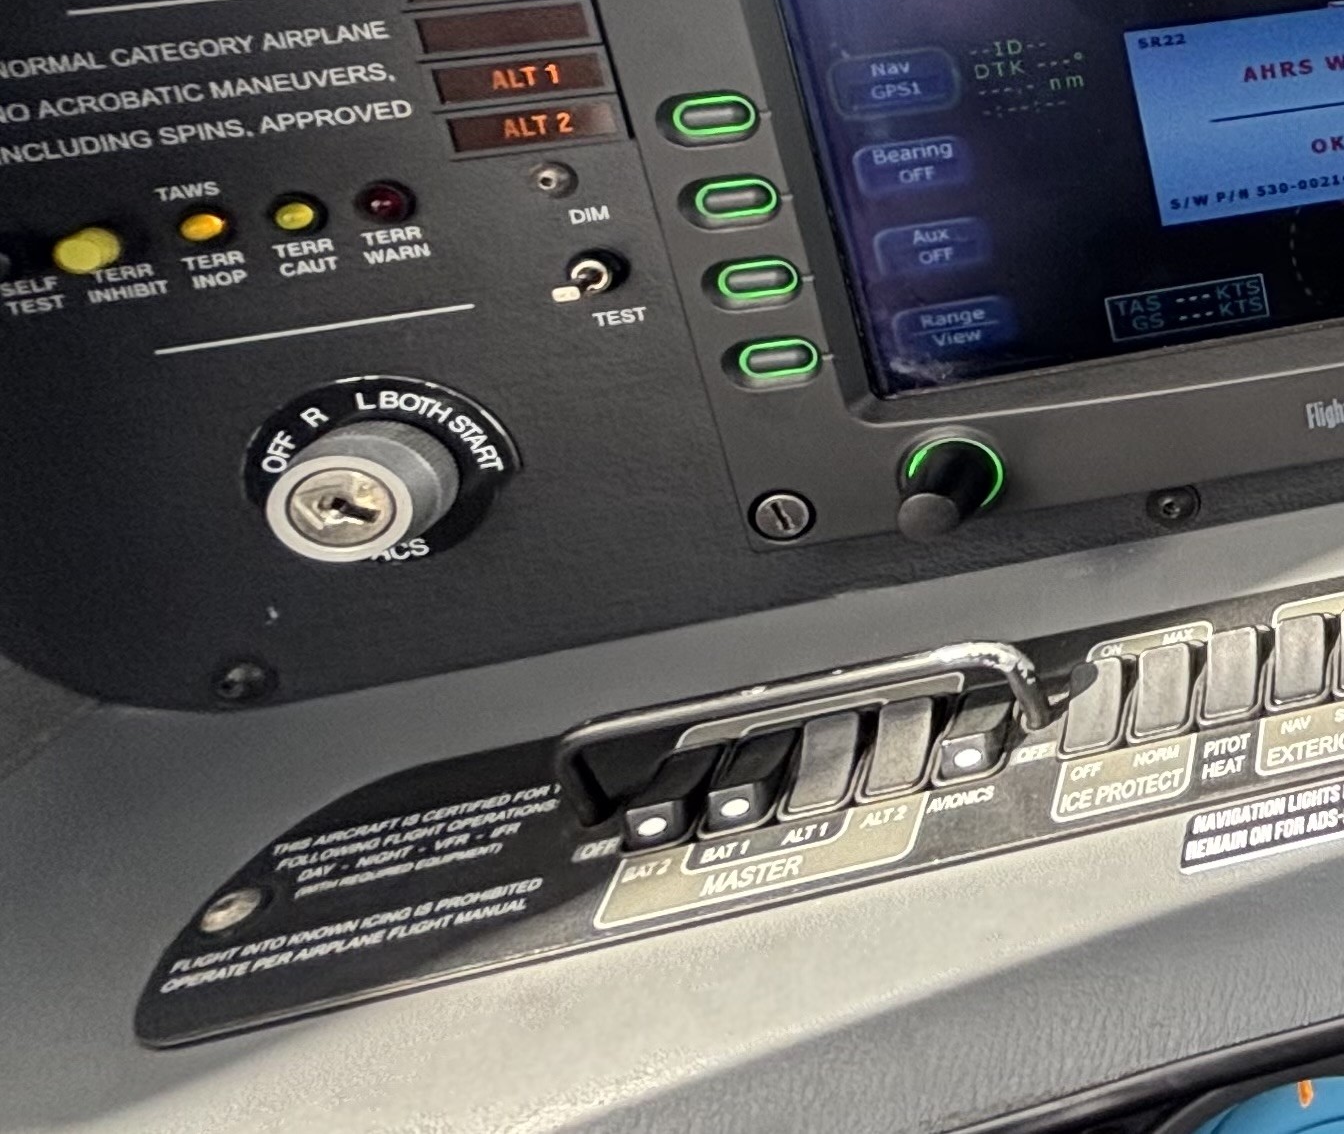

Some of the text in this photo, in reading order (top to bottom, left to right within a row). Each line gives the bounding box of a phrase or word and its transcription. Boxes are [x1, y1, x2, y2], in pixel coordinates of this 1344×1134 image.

[110, 21, 390, 68] CATEGORY AIRPLANE
[492, 65, 559, 90] ALT 1
[1243, 59, 1314, 84] AHRS
[39, 63, 396, 119] ACROBATIC MANEUVERS,
[260, 99, 412, 135] APPROVED
[503, 113, 573, 138] ALT 2
[872, 141, 954, 166] Bearing
[1311, 136, 1344, 154] OK
[155, 181, 221, 202] TAWS
[568, 206, 610, 225] DIM
[273, 238, 335, 259] TERR
[362, 226, 424, 248] TERR
[363, 241, 431, 266] WARN
[279, 257, 338, 278] CAUT
[88, 280, 169, 305] INHIBIT
[593, 307, 647, 329] TEST
[379, 390, 450, 424] BOTH
[261, 432, 297, 475] OFF
[448, 415, 504, 473] START
[1204, 734, 1251, 759] PITOT
[1202, 756, 1245, 780] HEAT
[927, 785, 995, 814] AVIONICS
[1061, 769, 1184, 813] ICE PROTECT
[1193, 798, 1286, 833] NAVIGATION
[1289, 784, 1341, 816] LIGHTS
[1186, 830, 1248, 860] REMAIN
[1250, 824, 1270, 846] ON
[1275, 816, 1304, 841] FOR
[702, 856, 802, 896] MASTER
[170, 877, 543, 973] FLIGHT INTO KNOWN ICING PROHIBITED
